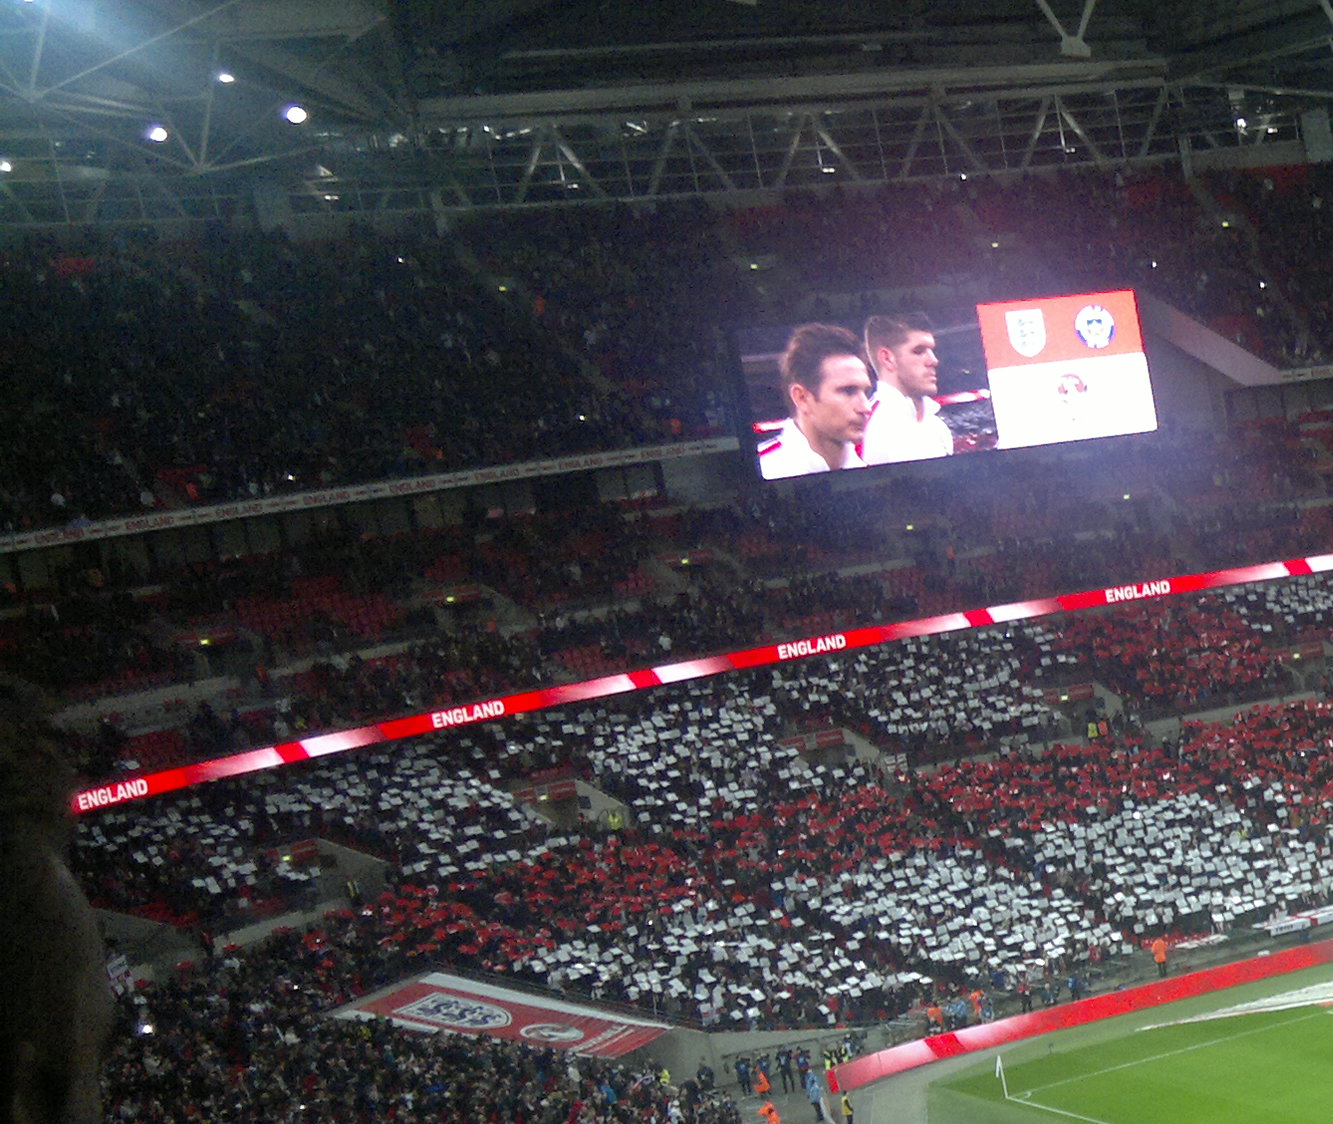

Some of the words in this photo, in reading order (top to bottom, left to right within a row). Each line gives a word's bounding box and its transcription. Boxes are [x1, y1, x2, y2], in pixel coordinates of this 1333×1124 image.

[78, 779, 148, 810] ENGLAND
[432, 701, 505, 729] ENGLAND
[778, 634, 846, 659] ENGLAND
[1105, 580, 1171, 603] ENGLAND
